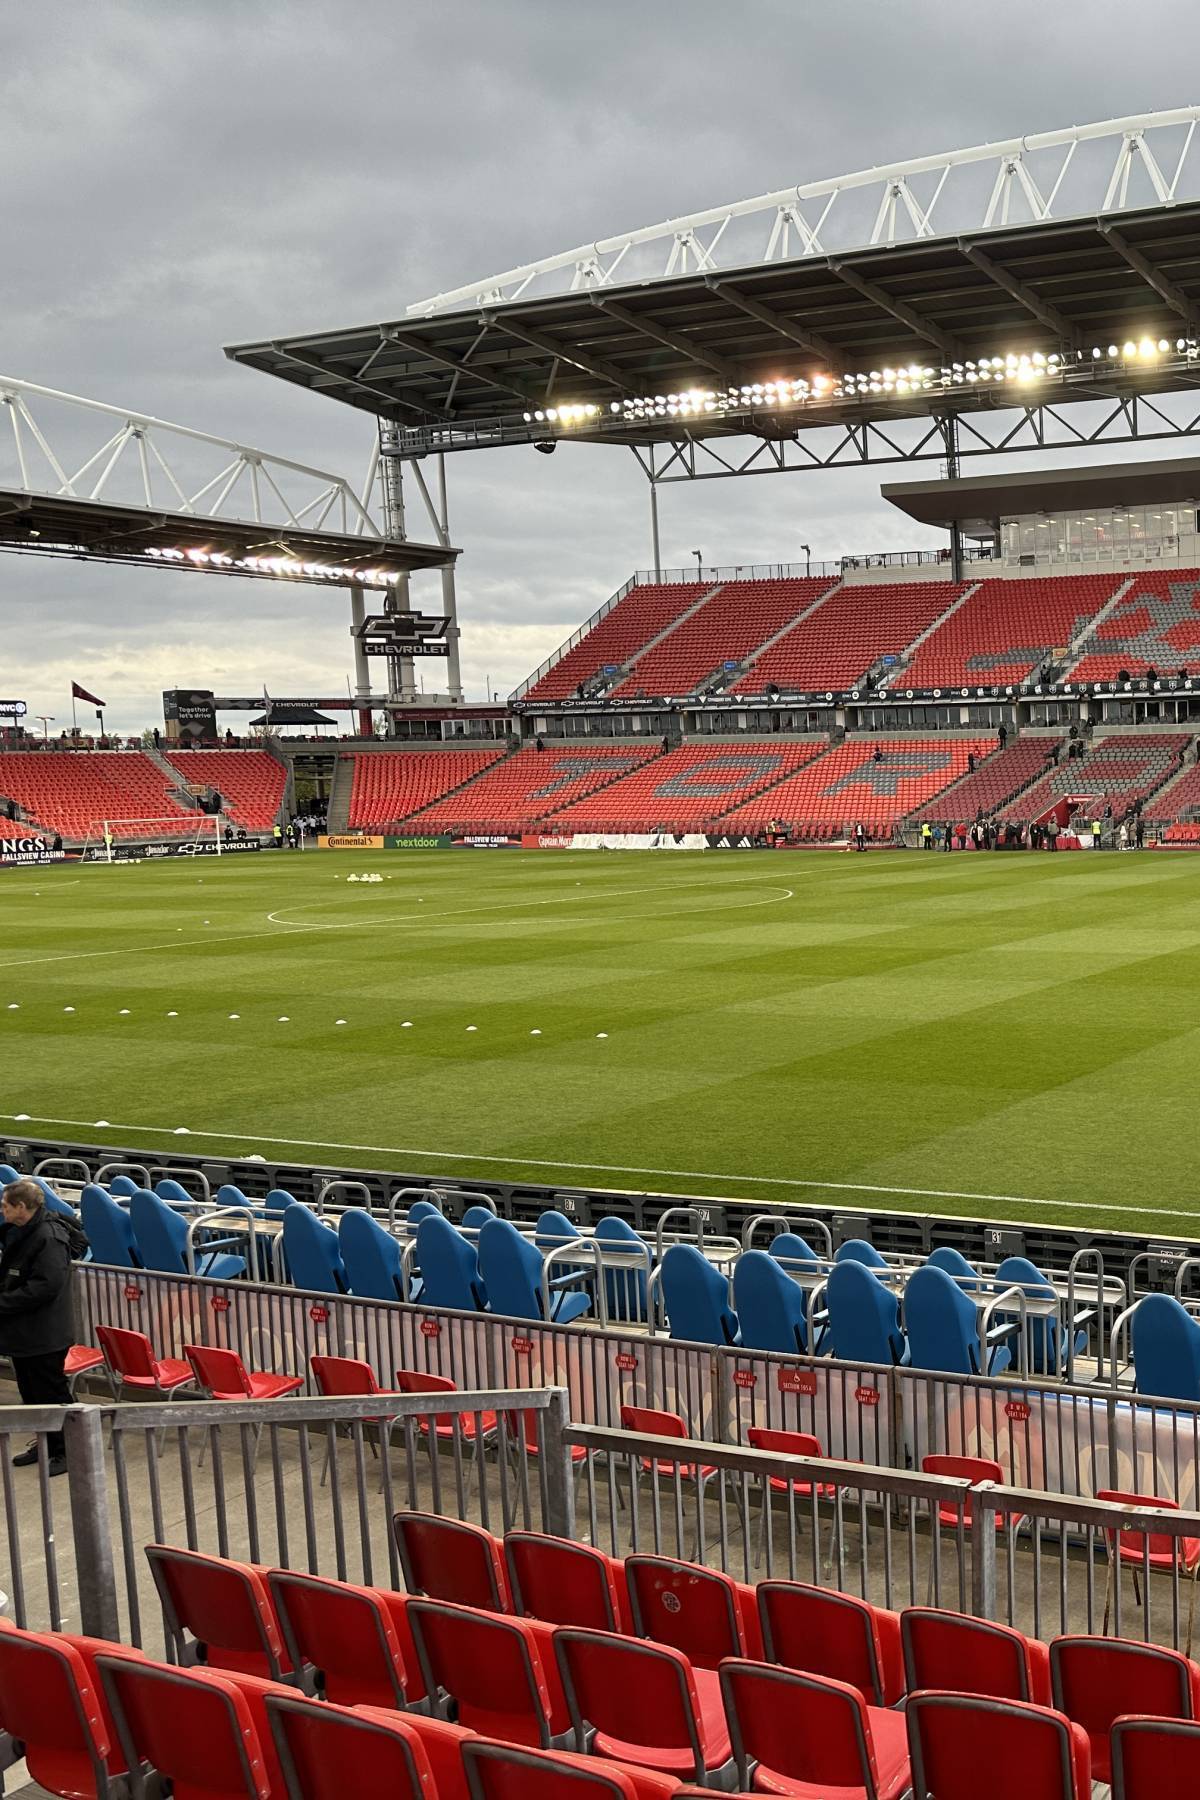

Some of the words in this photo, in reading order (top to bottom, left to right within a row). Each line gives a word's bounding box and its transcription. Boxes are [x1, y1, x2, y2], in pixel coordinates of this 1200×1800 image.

[364, 644, 447, 654] CHEVROLET
[179, 706, 209, 714] Together
[205, 842, 259, 851] CHEVROLET
[327, 836, 367, 847] Continental
[396, 837, 439, 848] nextdoor
[2, 852, 39, 862] FALLSVIEW
[40, 850, 65, 859] CASINO
[565, 1199, 575, 1210] 87
[992, 1231, 1001, 1243] 31
